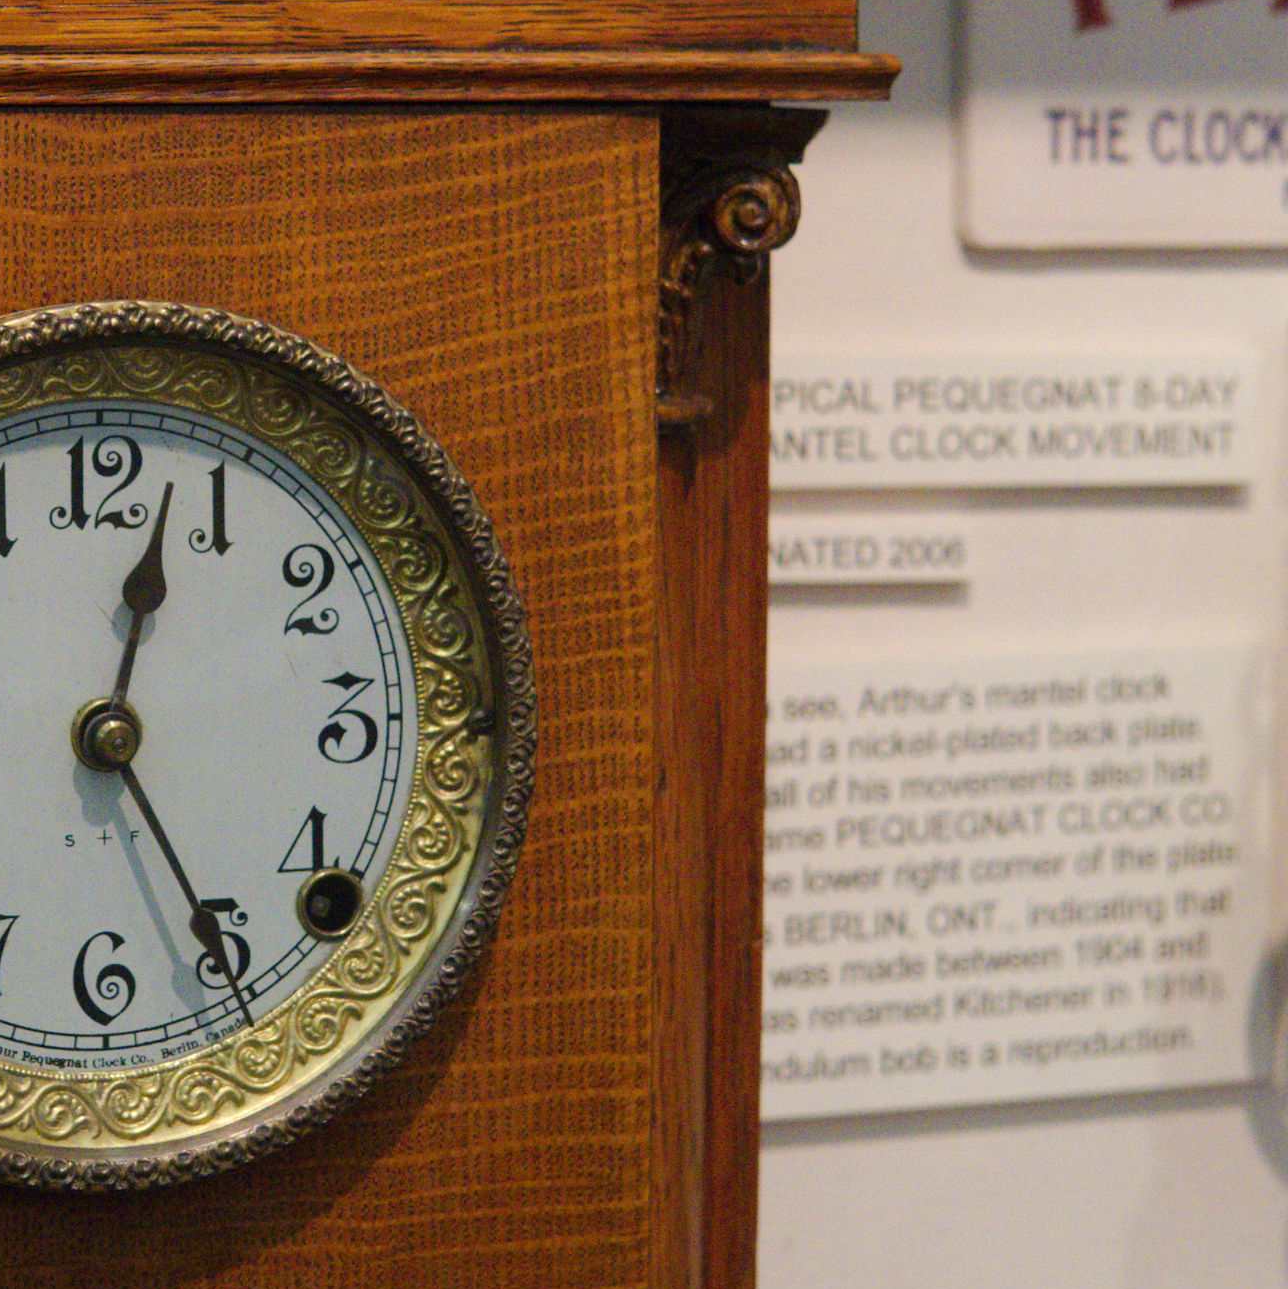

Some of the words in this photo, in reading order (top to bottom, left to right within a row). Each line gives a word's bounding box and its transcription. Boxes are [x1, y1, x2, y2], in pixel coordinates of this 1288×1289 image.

[1045, 108, 1130, 166] THE
[893, 375, 1120, 414] PEQUEGNAT
[889, 422, 1017, 463] CLOCK
[1027, 419, 1235, 460] MOVEMENT
[47, 433, 149, 533] 12
[187, 460, 235, 557] 1
[888, 533, 968, 569] 2006
[281, 542, 340, 637] 2
[984, 674, 1085, 708] mantel
[1094, 671, 1170, 704] clock
[316, 670, 378, 765] 3
[1048, 719, 1117, 750] back
[807, 774, 840, 807] of
[847, 776, 892, 805] his
[899, 764, 1075, 800] movements
[1153, 755, 1209, 784] had
[64, 833, 76, 848] S
[129, 829, 141, 844] F
[276, 804, 341, 874] 4
[835, 802, 1047, 849] PEQUEGNAT
[1056, 797, 1171, 837] CLOCK
[802, 864, 884, 895] lower
[893, 858, 962, 896] right
[968, 852, 1065, 884] corner
[1073, 841, 1106, 878] of
[1112, 843, 1159, 875] the
[1025, 893, 1167, 931] indicating
[1174, 884, 1235, 919] that
[195, 897, 250, 990] 5
[769, 962, 831, 990] was
[838, 953, 929, 986] made
[933, 945, 1064, 982] between
[1153, 930, 1210, 959] and
[72, 930, 137, 1027] 6
[808, 993, 946, 1030] renamed
[952, 984, 1094, 1017] Kitchener
[21, 1049, 88, 1070] Pequegnat
[91, 1055, 127, 1070] Clock
[878, 1044, 939, 1077] bob
